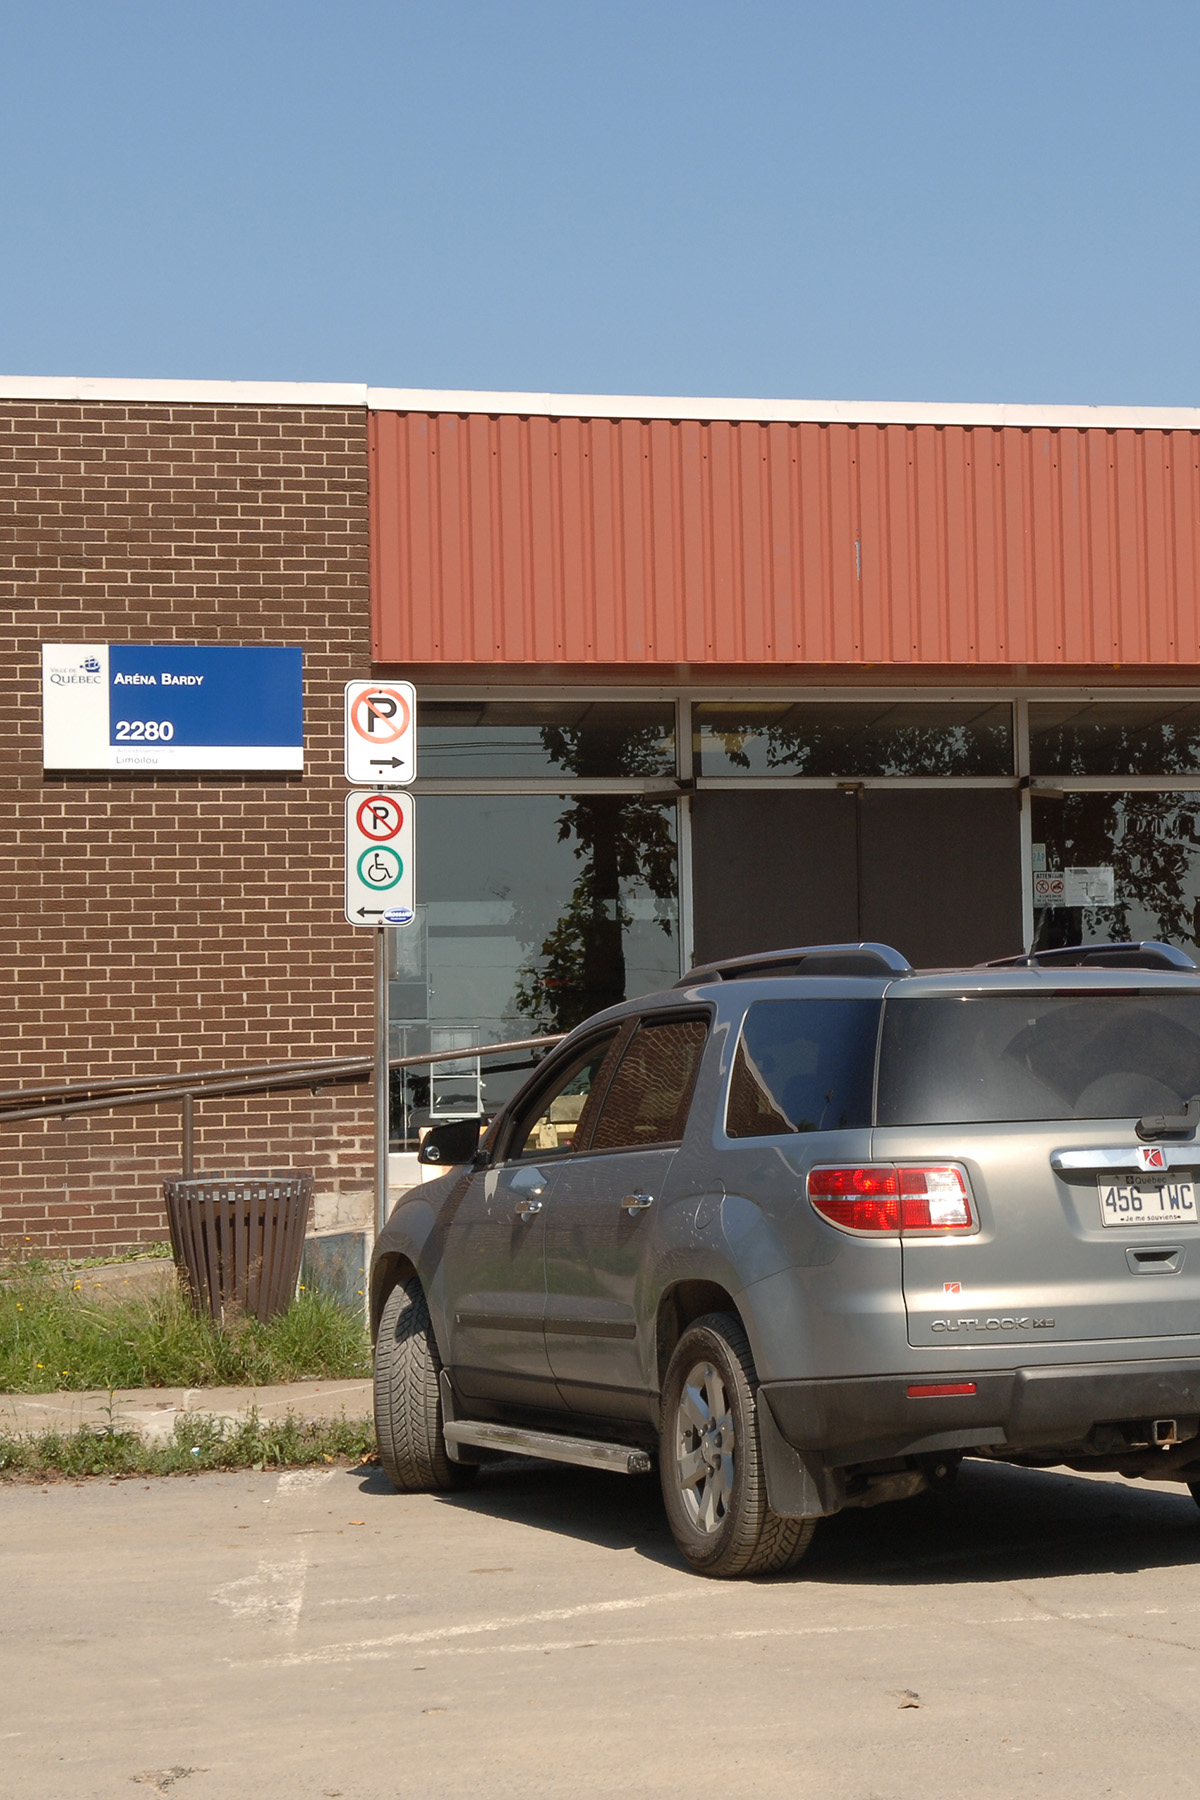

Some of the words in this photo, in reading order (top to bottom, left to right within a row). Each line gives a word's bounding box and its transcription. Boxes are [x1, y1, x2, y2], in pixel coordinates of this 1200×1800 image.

[50, 674, 101, 686] QUÉBEC
[161, 673, 204, 686] BARDY
[115, 721, 174, 741] 2280
[116, 756, 158, 764] Limoilou
[1135, 1176, 1167, 1185] Québec
[1105, 1186, 1143, 1213] 456
[1154, 1184, 1193, 1211] TWC
[1147, 1213, 1178, 1221] souviens
[931, 1317, 1030, 1333] OUTLOOK
